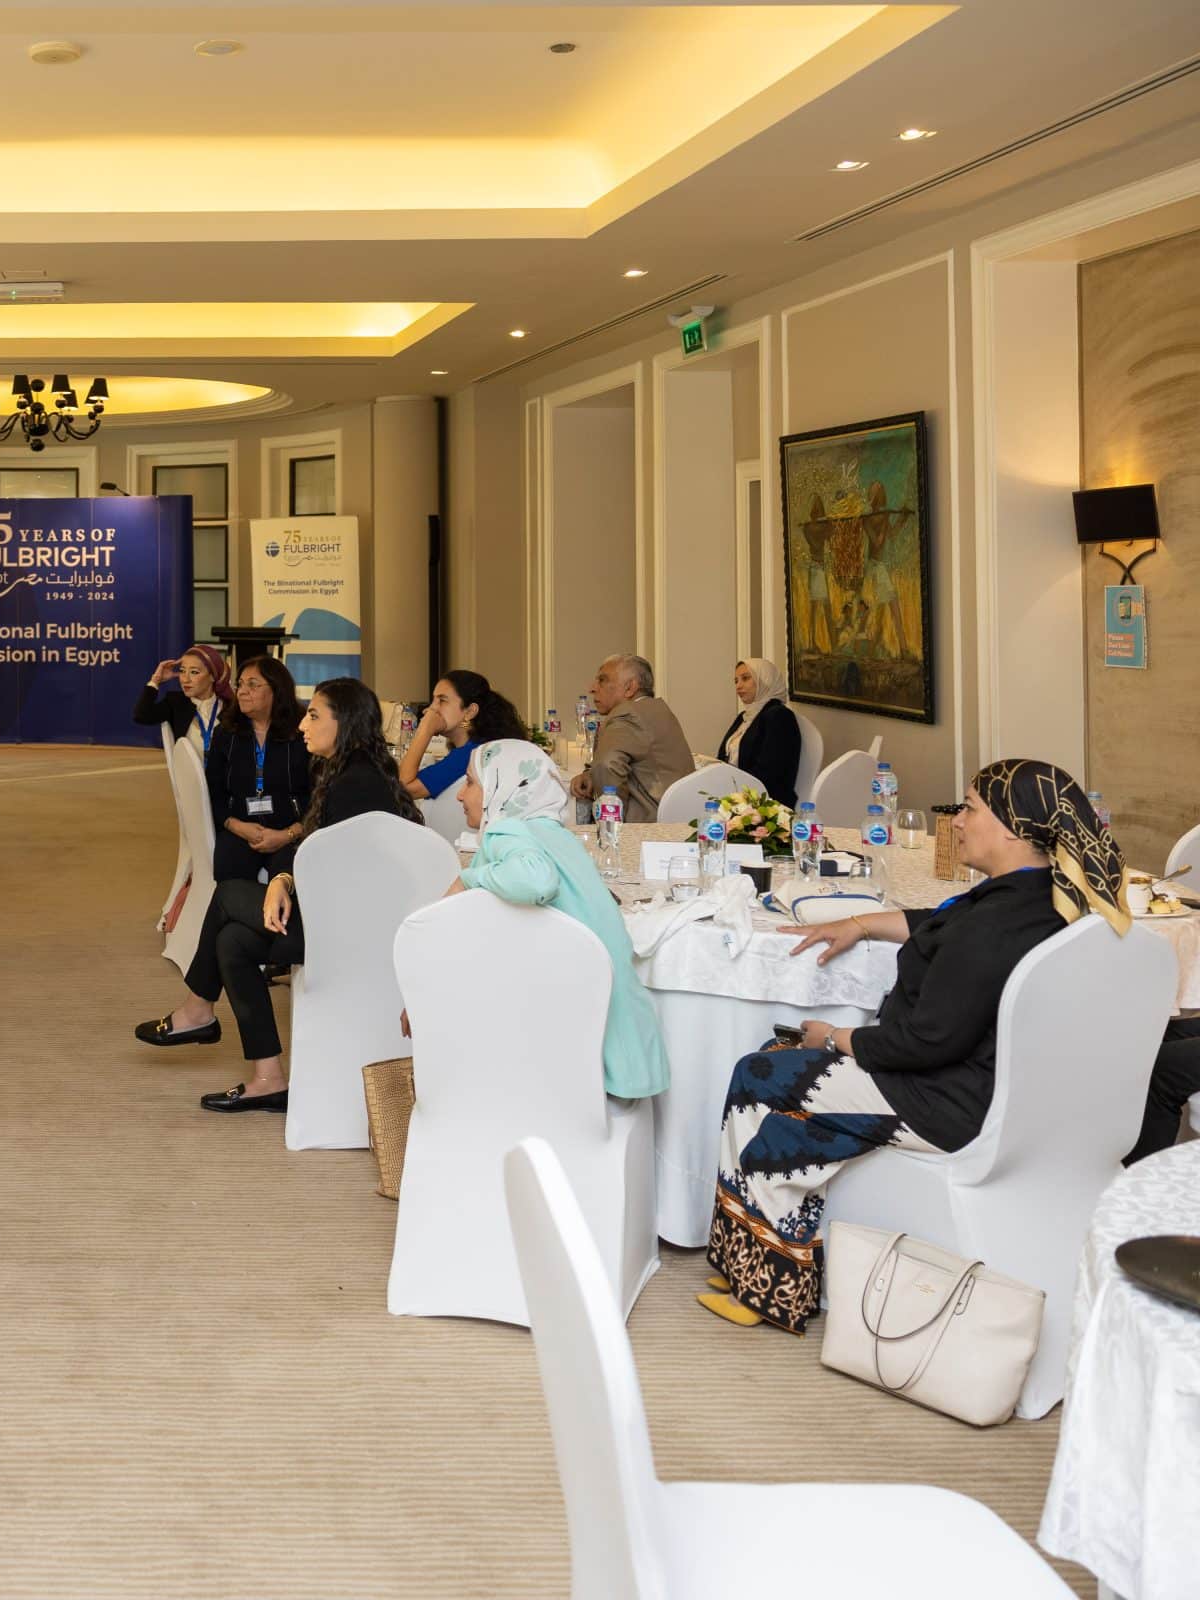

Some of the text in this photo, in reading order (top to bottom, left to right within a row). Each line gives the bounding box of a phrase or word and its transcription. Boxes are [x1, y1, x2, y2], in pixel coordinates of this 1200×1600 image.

[19, 528, 86, 542] YEARS
[90, 528, 116, 542] OF
[283, 530, 301, 544] 75
[283, 543, 341, 553] FULBRIGHT
[45, 570, 115, 588] فولبرايت
[313, 579, 344, 587] Fulbright
[45, 591, 74, 601] 1949
[87, 591, 115, 601] 2024
[320, 588, 339, 596] Egypt
[46, 622, 133, 642] Fulbright
[41, 645, 60, 663] in
[65, 646, 120, 666] Egypt
